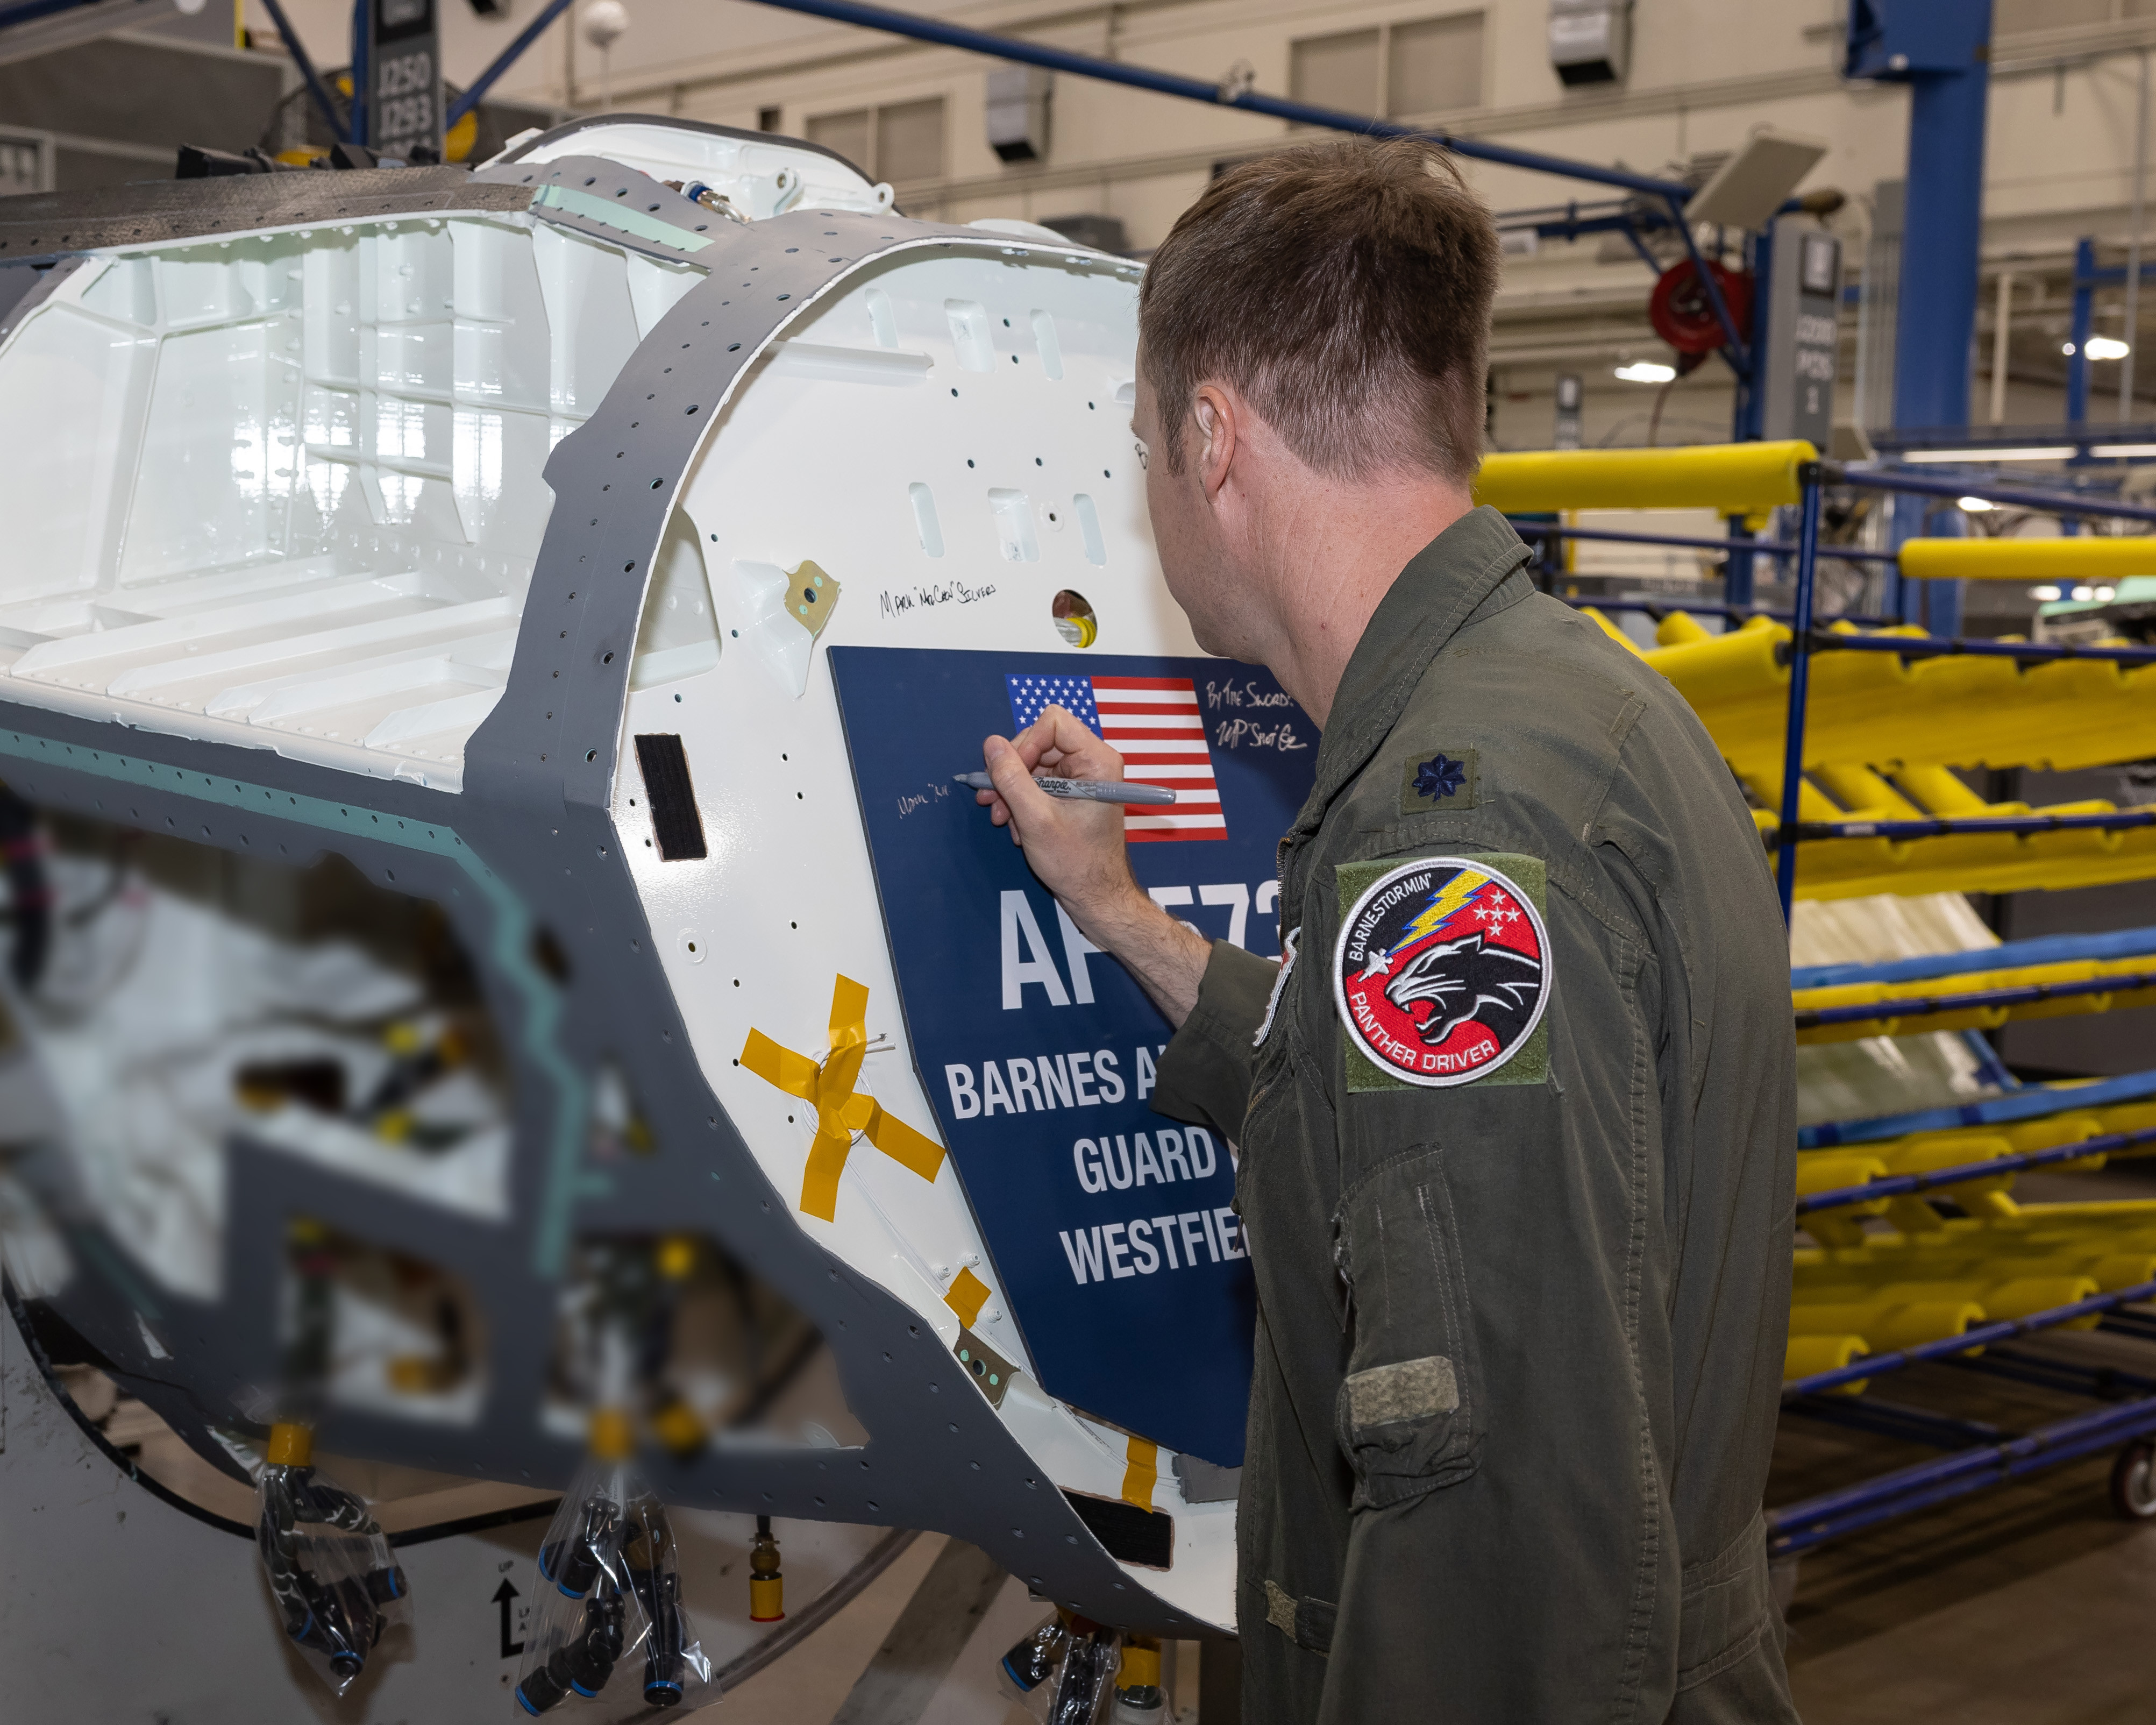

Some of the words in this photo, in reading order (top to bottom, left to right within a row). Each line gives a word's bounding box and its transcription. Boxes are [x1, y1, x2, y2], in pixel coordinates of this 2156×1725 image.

[1348, 873, 1432, 961] BARNESTORMIN'
[1350, 992, 1417, 1066] PANTHER
[1422, 1039, 1495, 1071] DRIVER
[945, 1045, 1126, 1119] BARNES
[1073, 1126, 1216, 1194] GUARD
[1059, 1206, 1251, 1285] WESTFIE
